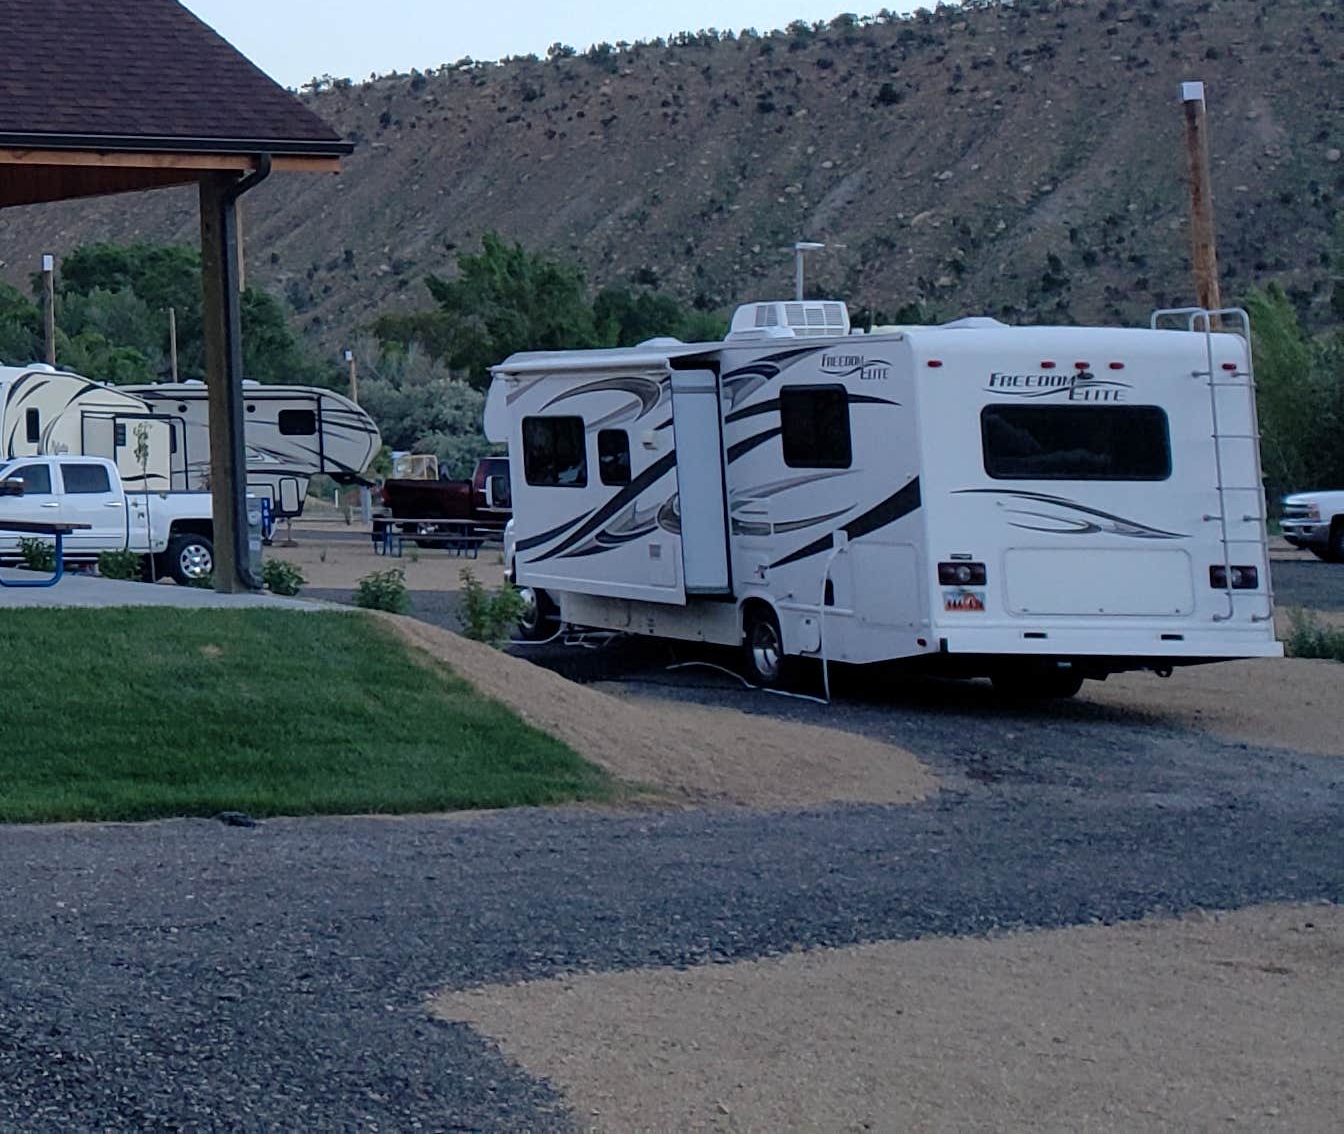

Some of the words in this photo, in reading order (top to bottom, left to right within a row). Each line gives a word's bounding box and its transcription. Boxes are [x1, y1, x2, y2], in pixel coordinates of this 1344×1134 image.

[821, 354, 864, 367] FREEDOM
[989, 373, 1076, 387] FREEDOM
[1069, 386, 1127, 401] ELITE
